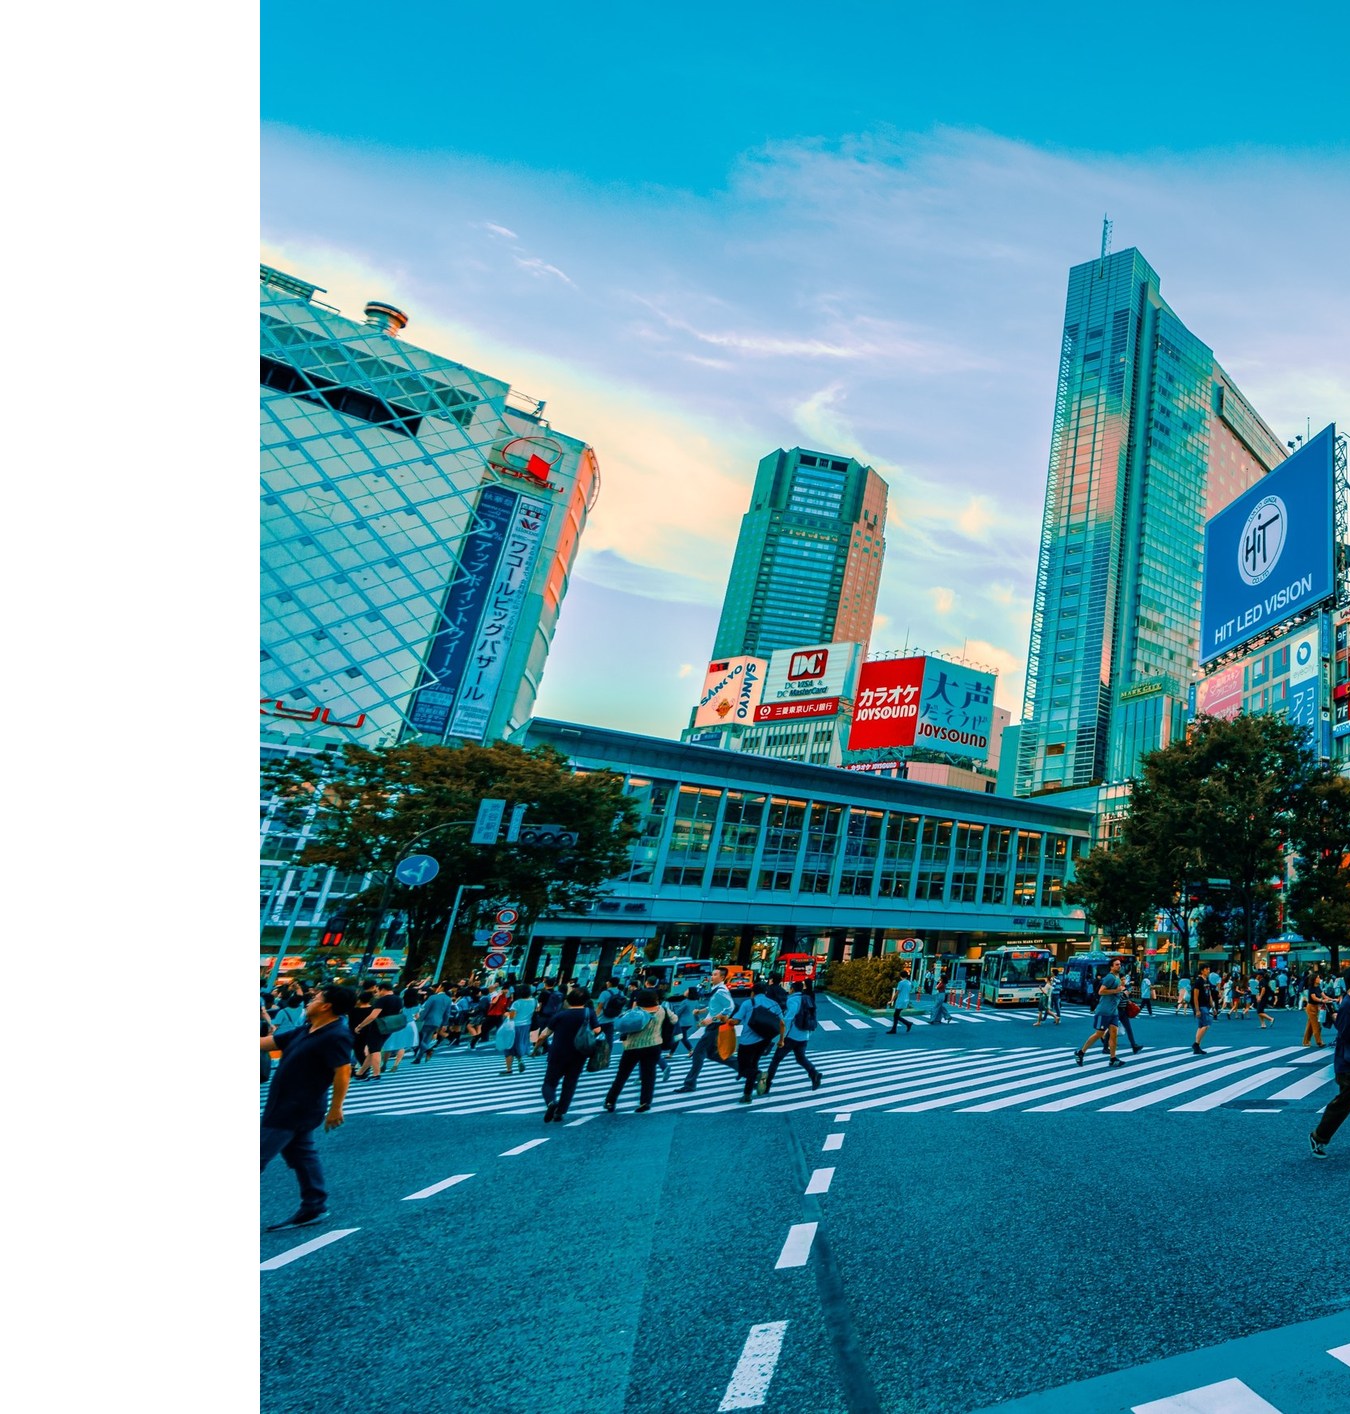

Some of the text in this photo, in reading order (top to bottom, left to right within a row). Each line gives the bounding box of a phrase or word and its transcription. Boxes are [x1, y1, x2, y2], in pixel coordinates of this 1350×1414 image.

[463, 540, 527, 701] ワコールビッグバザール
[1214, 573, 1312, 645] HIT LED VISION
[1337, 630, 1347, 642] 9F
[791, 652, 823, 677] DC
[700, 664, 743, 706] SANKYO
[737, 663, 759, 718] SANKYO
[777, 686, 828, 698] DC MasterCard
[785, 681, 796, 690] DC
[797, 680, 814, 688] VISA
[858, 684, 919, 707] カラオケ
[925, 671, 993, 709] 大声
[775, 702, 833, 716] 三菱東京UFJ銀行
[856, 704, 917, 721] JOYSOUND
[1337, 705, 1348, 719] 7F
[918, 723, 987, 748] JOYSOUND
